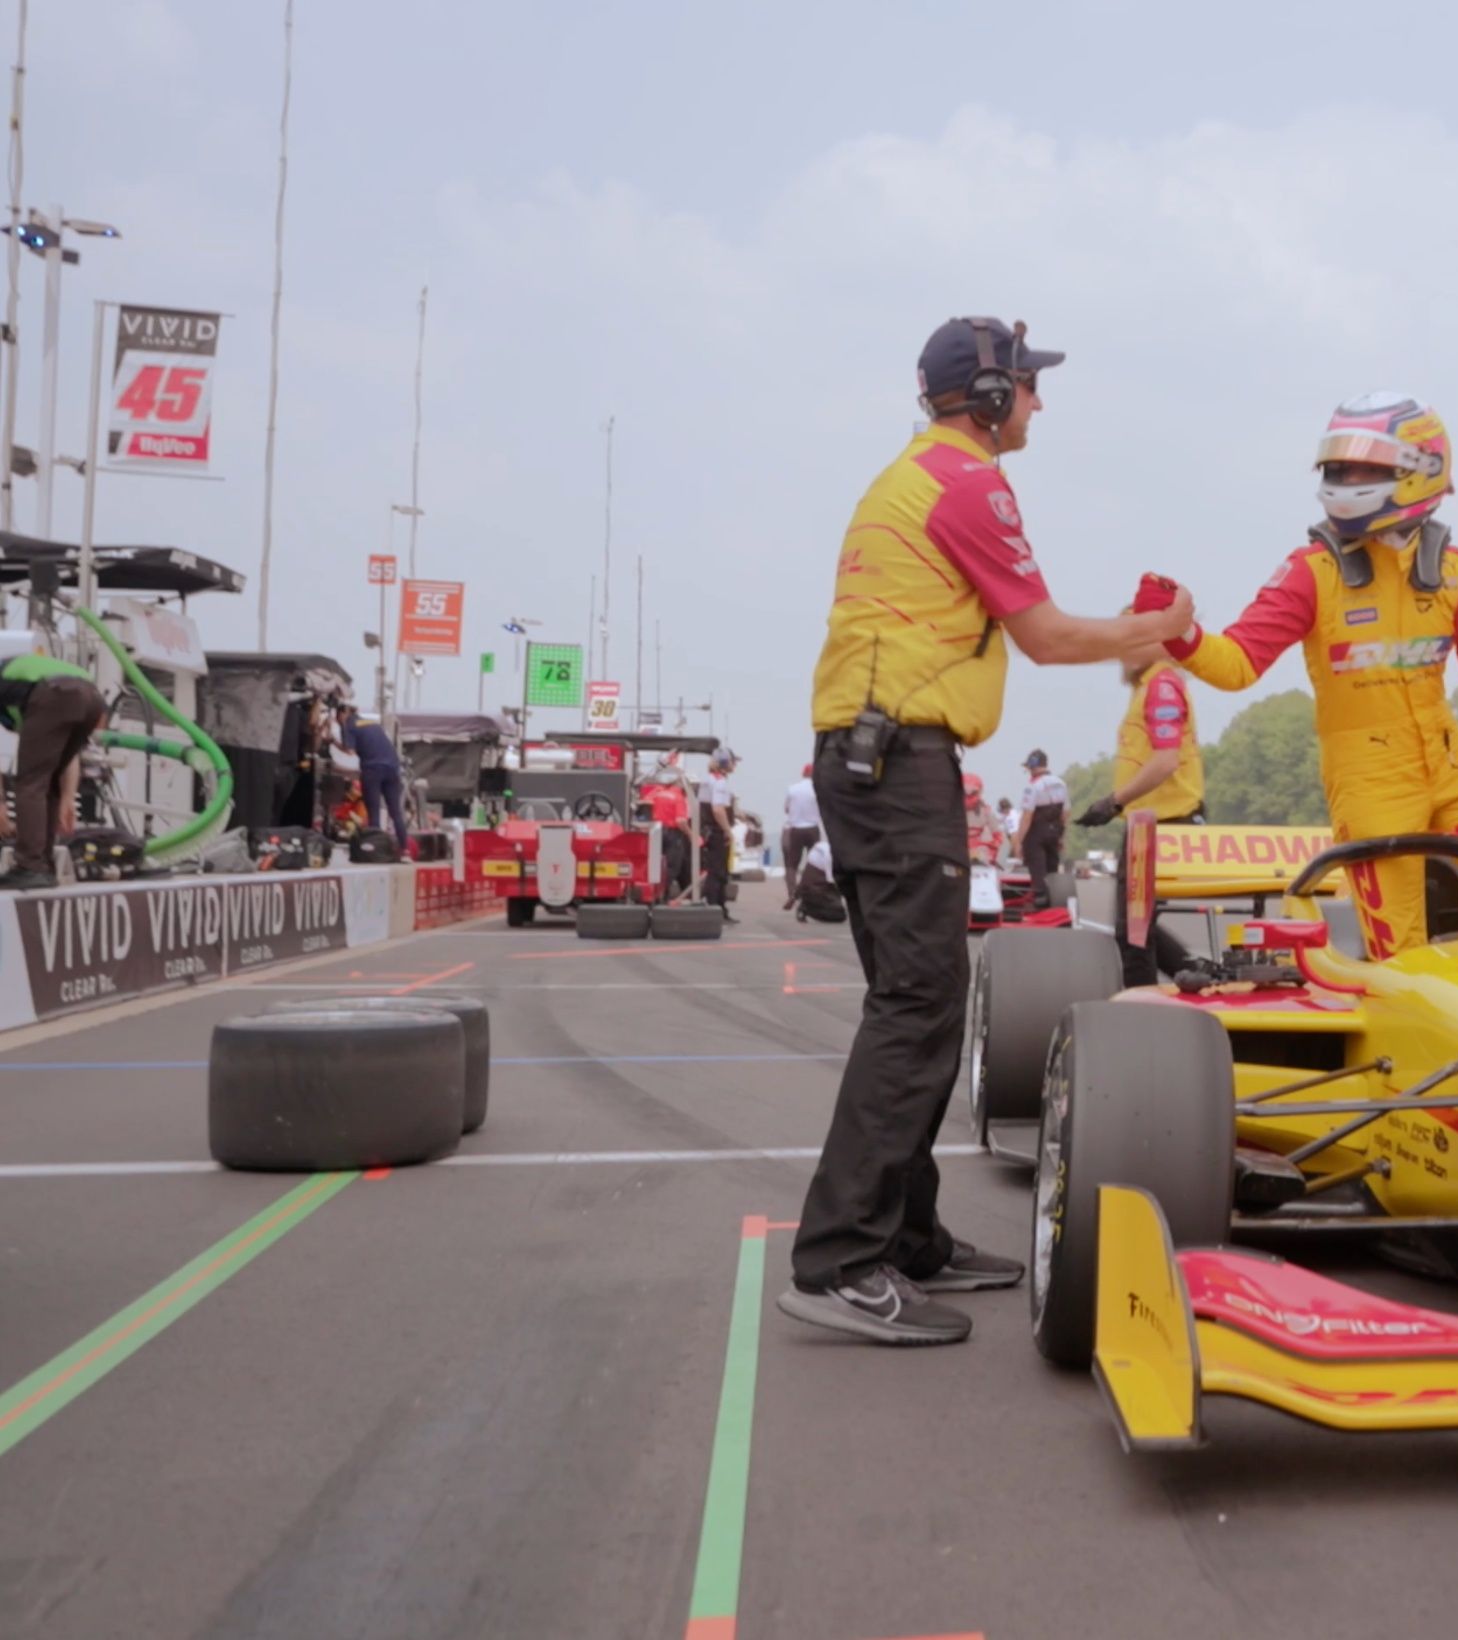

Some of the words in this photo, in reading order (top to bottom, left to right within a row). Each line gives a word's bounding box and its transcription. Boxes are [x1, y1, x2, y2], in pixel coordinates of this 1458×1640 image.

[122, 313, 217, 341] VIVID
[117, 363, 208, 423] 45
[370, 562, 395, 580] 55
[414, 591, 448, 616] 55
[147, 886, 221, 954] VIVID
[229, 883, 285, 941] VIVID
[293, 880, 339, 932] VIVID
[38, 892, 133, 973] VIVID
[60, 976, 97, 1003] CLEAR
